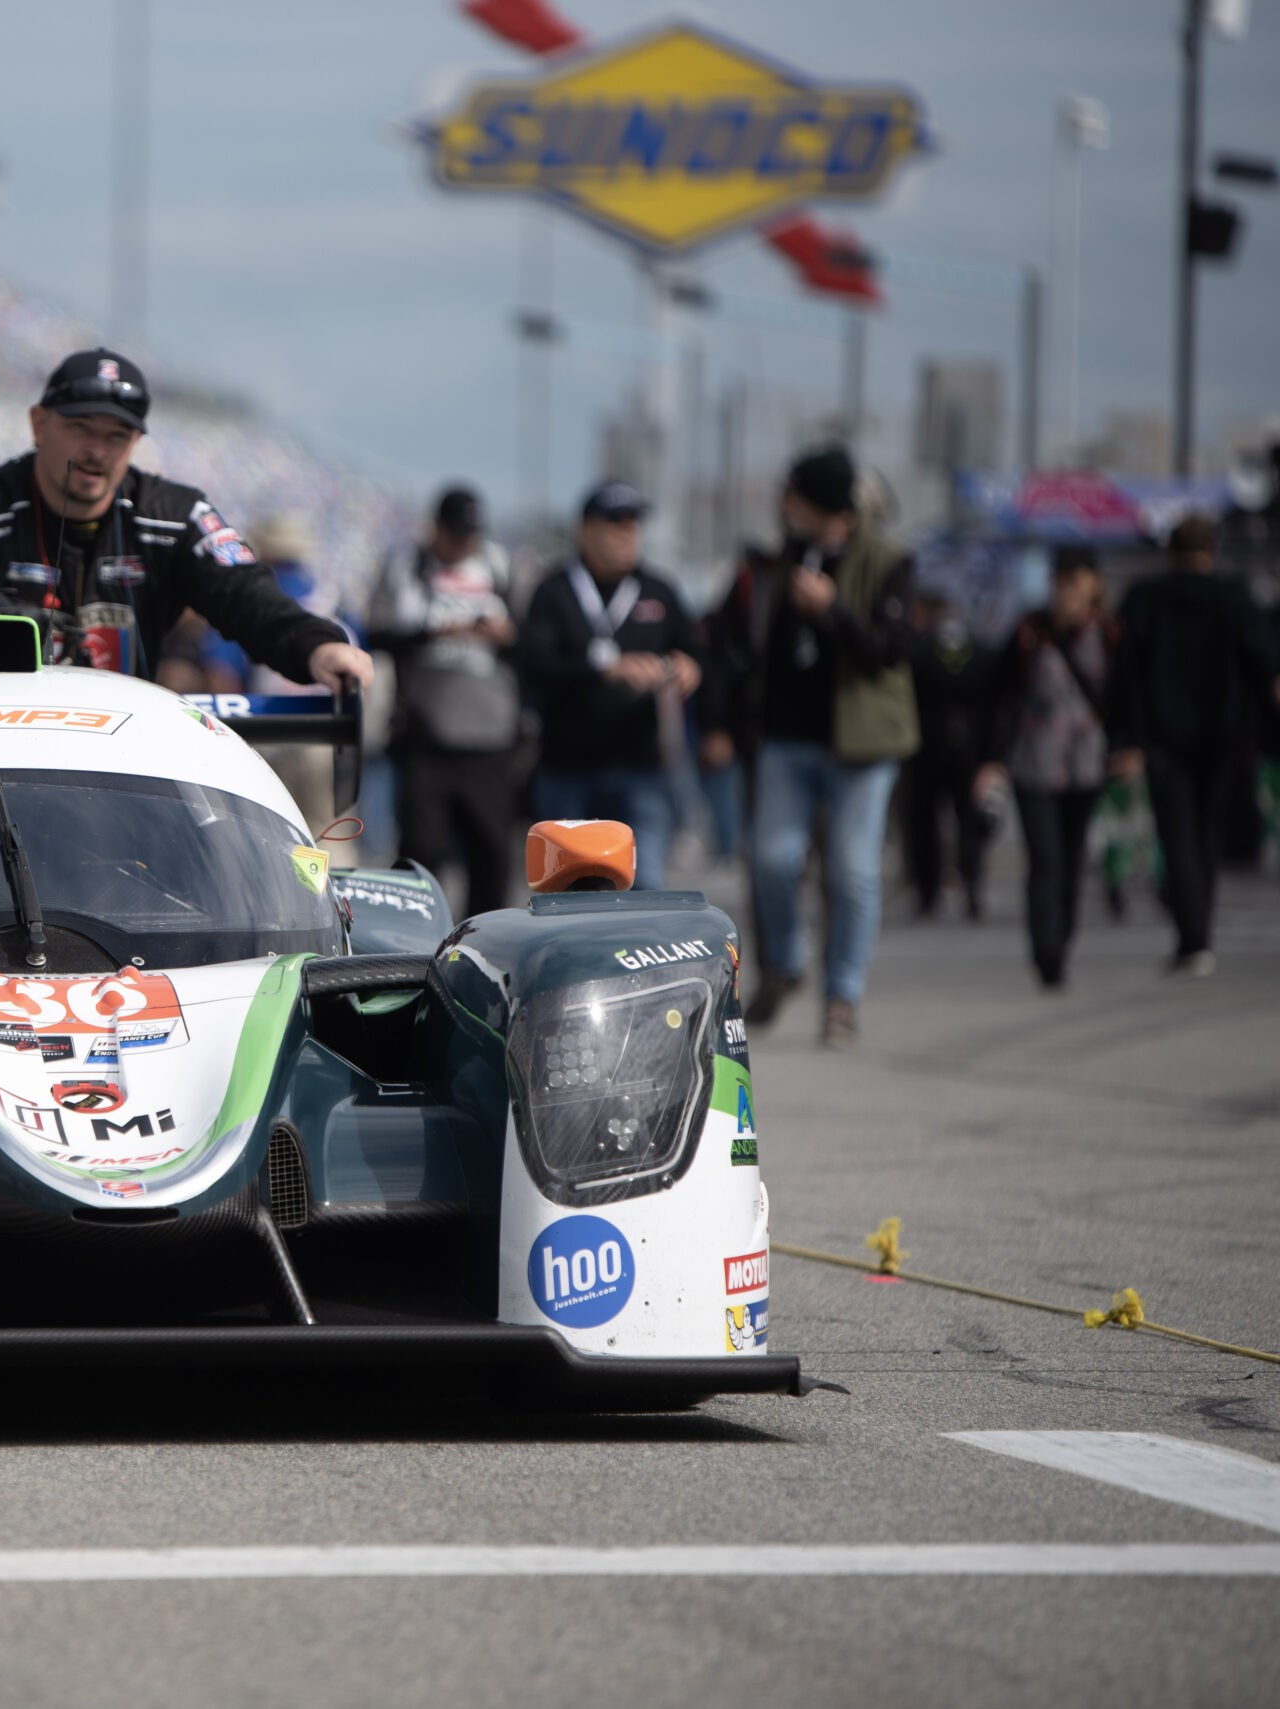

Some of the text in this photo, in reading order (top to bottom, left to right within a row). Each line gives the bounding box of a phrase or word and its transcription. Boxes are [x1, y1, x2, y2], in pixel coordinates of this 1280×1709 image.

[456, 98, 892, 178] SUNOCO
[308, 862, 319, 876] 9
[616, 940, 713, 970] GALLANT
[90, 1108, 176, 1141] Mi
[89, 1147, 185, 1165] IMSA
[543, 1240, 622, 1302] hoo
[554, 1286, 617, 1311] justhooit.com
